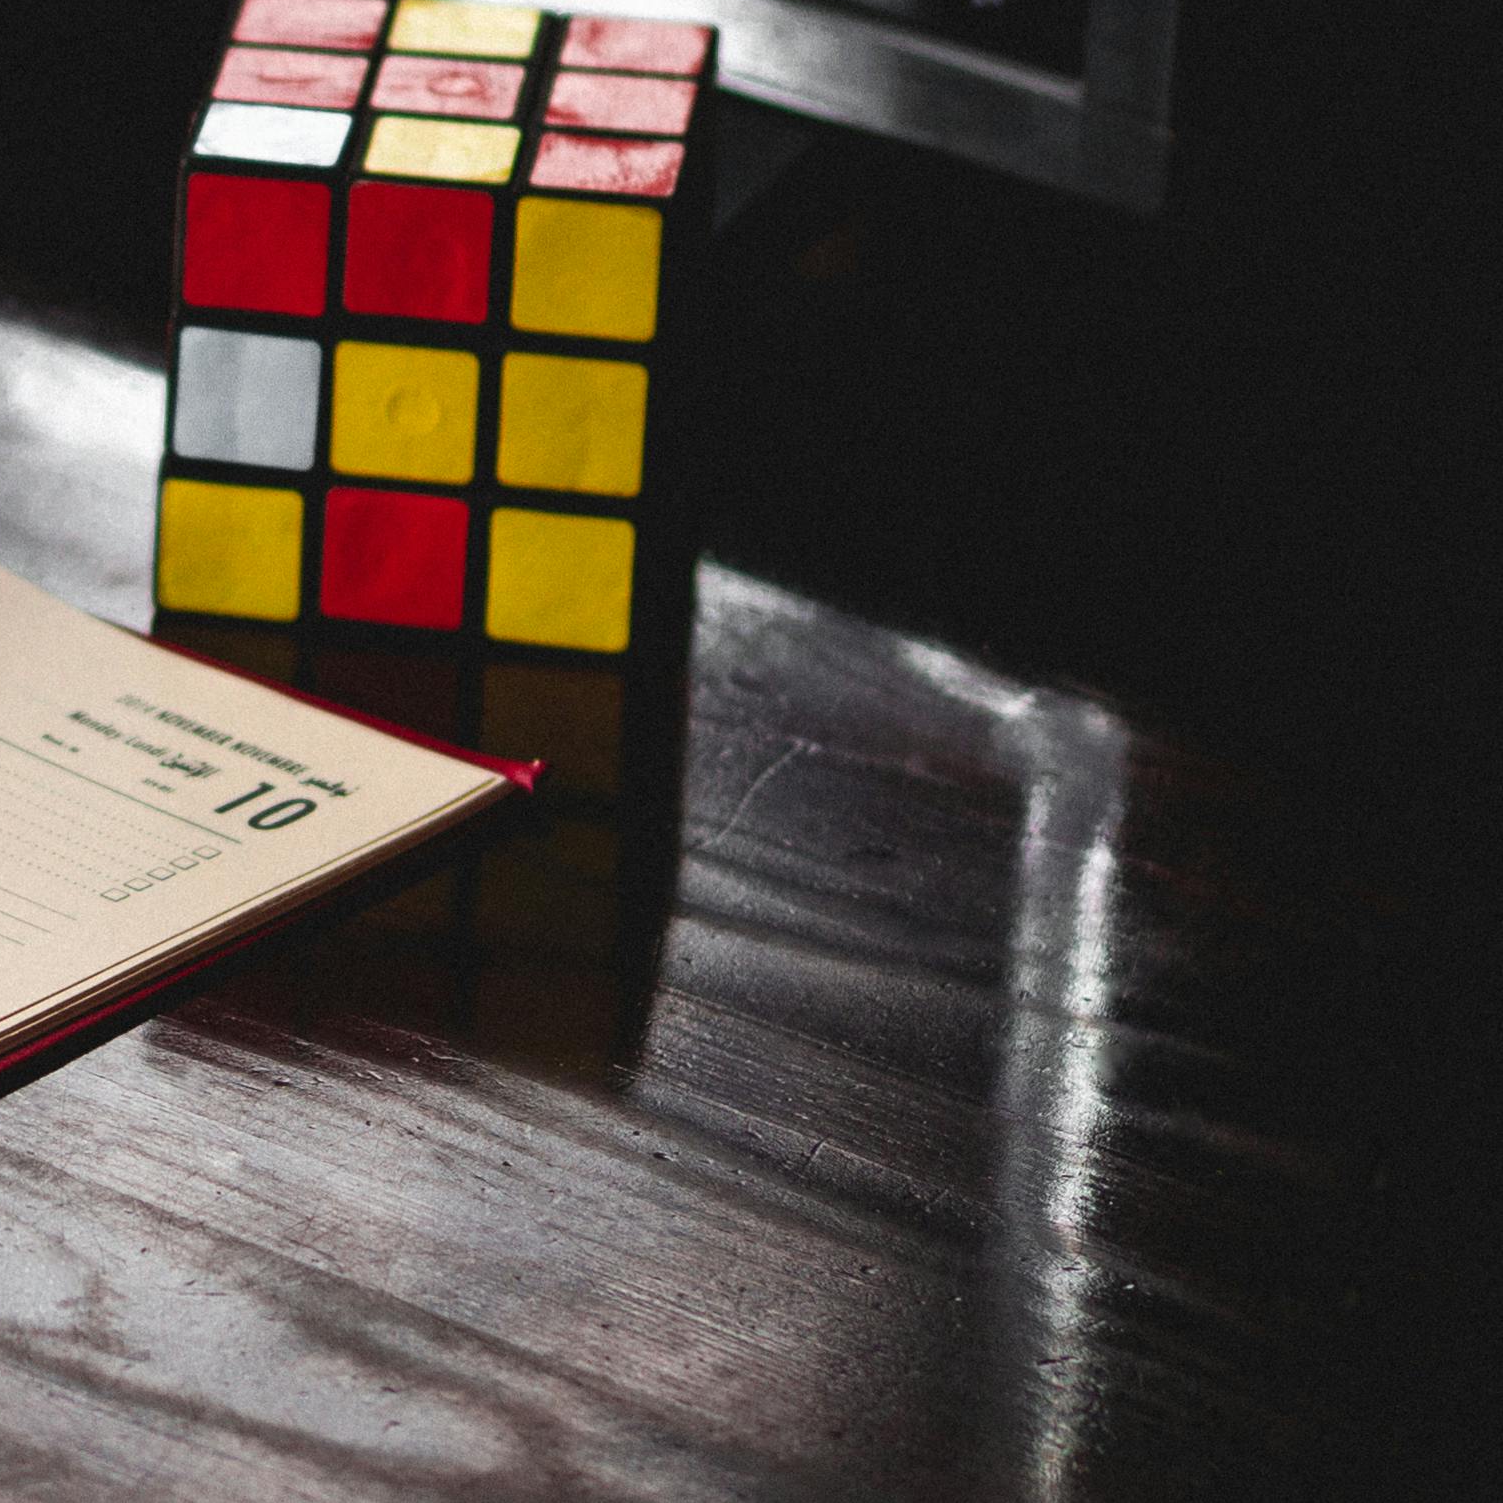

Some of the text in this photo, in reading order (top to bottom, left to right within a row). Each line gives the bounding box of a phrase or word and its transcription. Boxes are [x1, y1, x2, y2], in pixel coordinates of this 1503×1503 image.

[66, 710, 123, 740] Monday
[153, 709, 233, 746] NOVEMBER
[213, 781, 319, 832] 10
